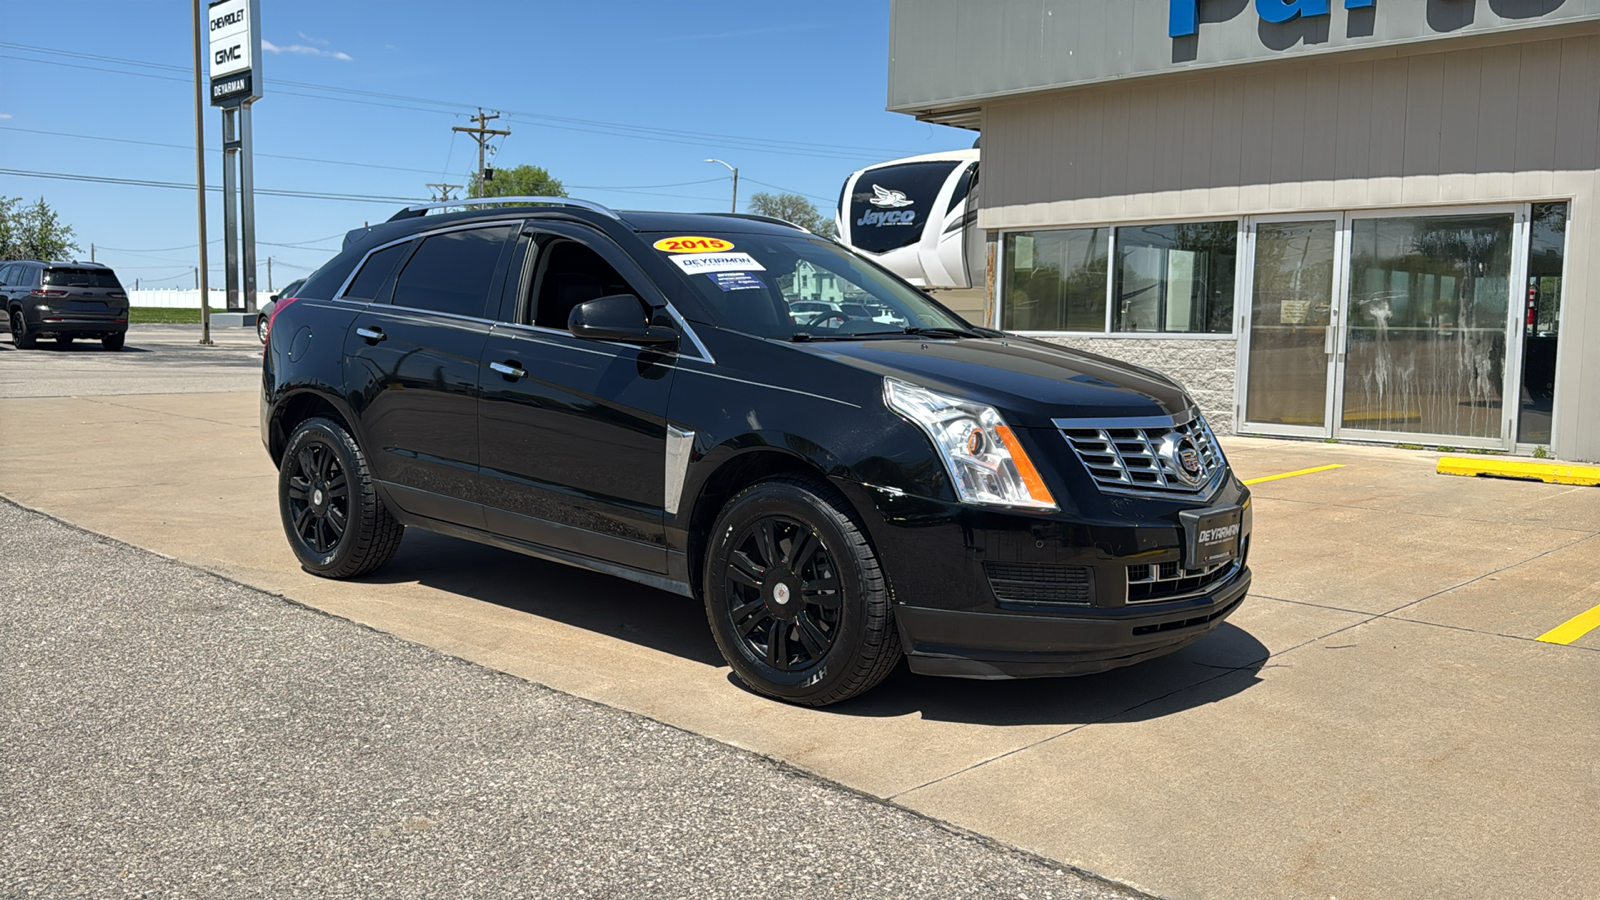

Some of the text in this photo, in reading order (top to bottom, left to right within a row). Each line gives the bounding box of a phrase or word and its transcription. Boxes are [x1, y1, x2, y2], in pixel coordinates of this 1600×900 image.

[210, 9, 244, 31] CHEVROLET
[215, 44, 241, 65] GMC
[214, 79, 245, 97] DEYARMAN
[857, 209, 915, 227] Jayco
[665, 240, 725, 250] 2015
[682, 258, 751, 266] DEYARMAN
[1198, 524, 1240, 543] DEYARMAN
